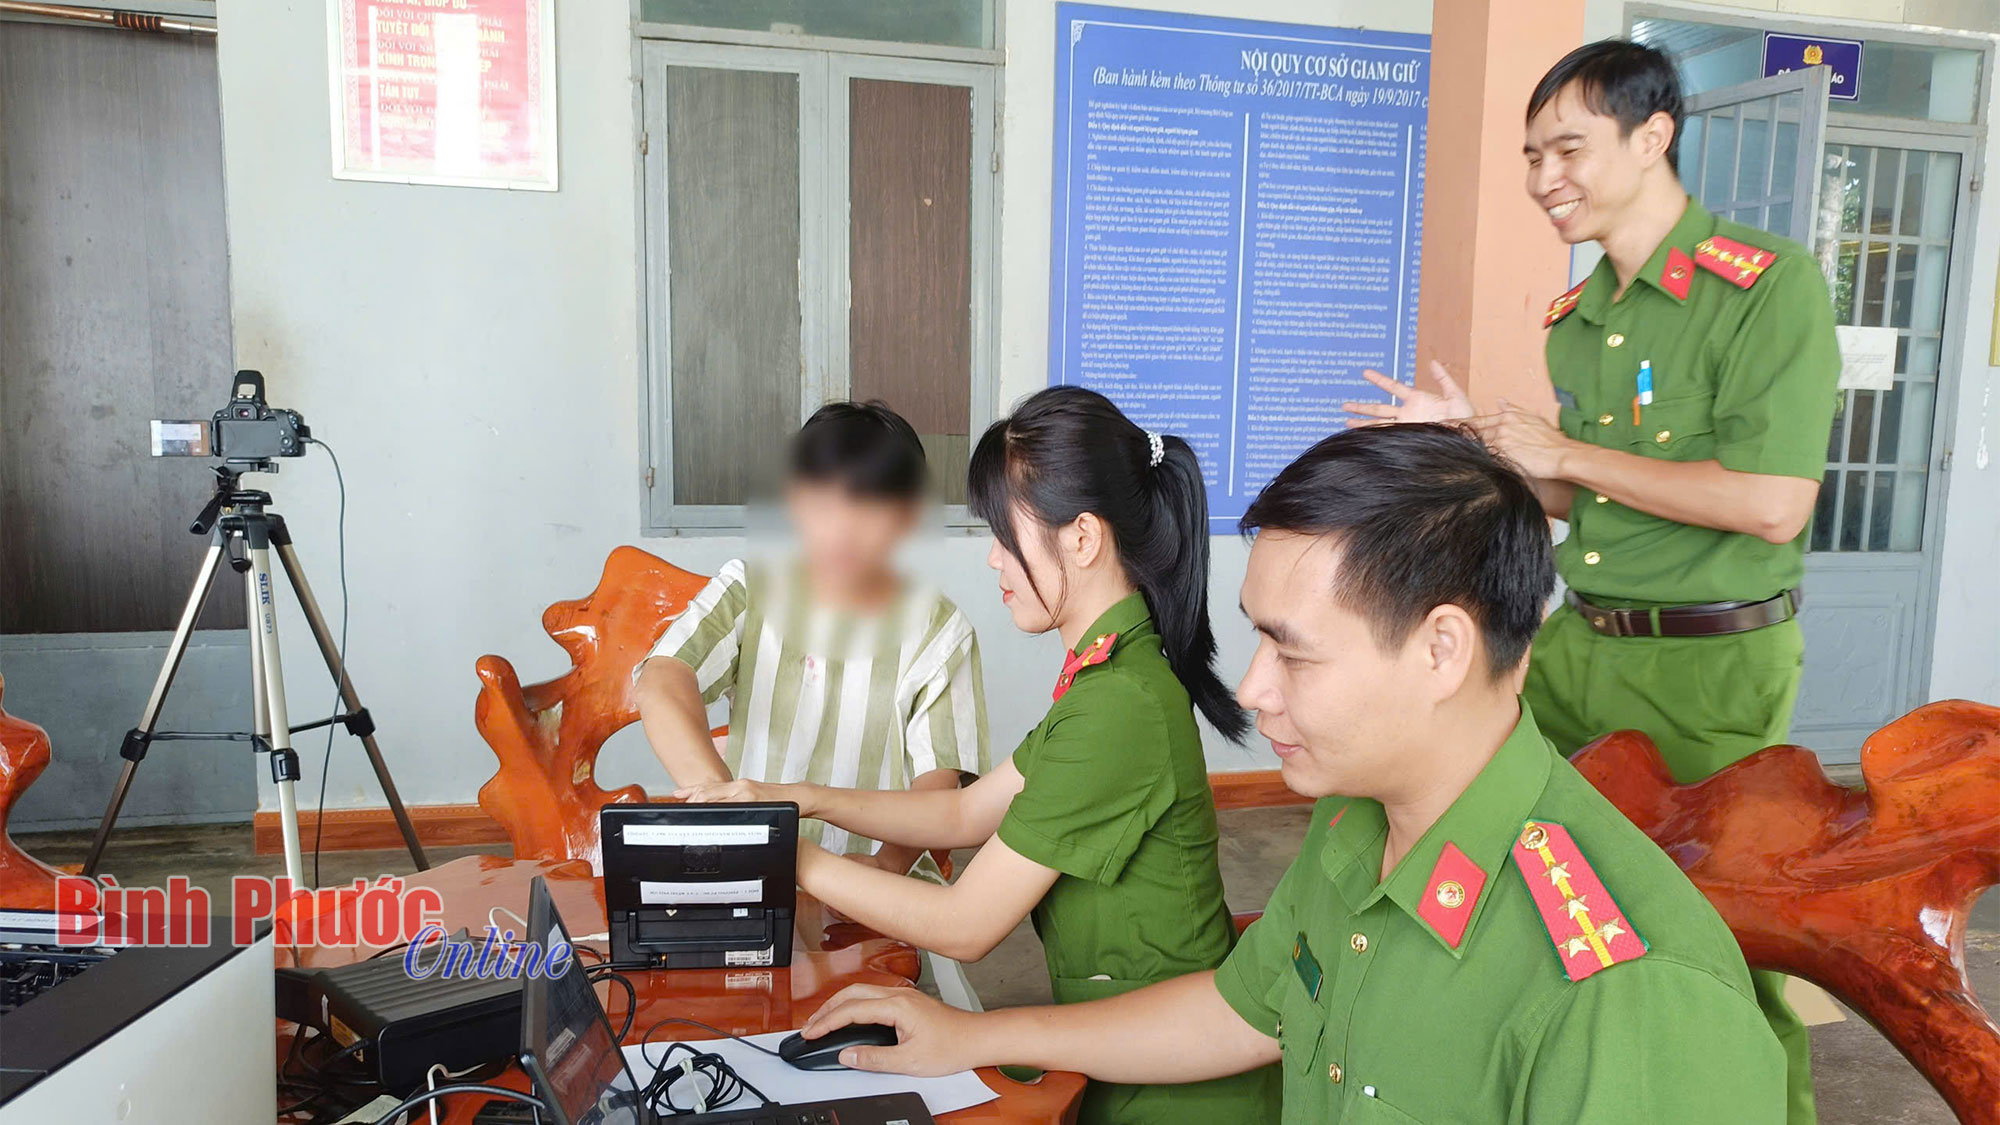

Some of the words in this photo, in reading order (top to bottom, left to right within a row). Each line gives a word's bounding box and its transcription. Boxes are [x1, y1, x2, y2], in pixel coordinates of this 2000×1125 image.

[1240, 48, 1267, 76] NỘI
[1271, 52, 1302, 76] QUY
[1304, 54, 1326, 77] CƠ
[1328, 53, 1349, 78] SỞ
[1350, 58, 1390, 82] GIAM
[1392, 60, 1421, 84] GIỮ
[1093, 66, 1118, 87] (Ban
[1121, 67, 1148, 88] hành
[1150, 70, 1170, 89] kèm
[1174, 72, 1196, 92] theo
[1200, 73, 1232, 98] Thông
[1233, 80, 1246, 94] tư
[1246, 76, 1258, 96] số
[1260, 78, 1344, 102] 36/2017/TT-BCA
[1344, 86, 1370, 108] ngày
[1372, 87, 1422, 108] 19/9/2017
[260, 572, 270, 605] SLIK
